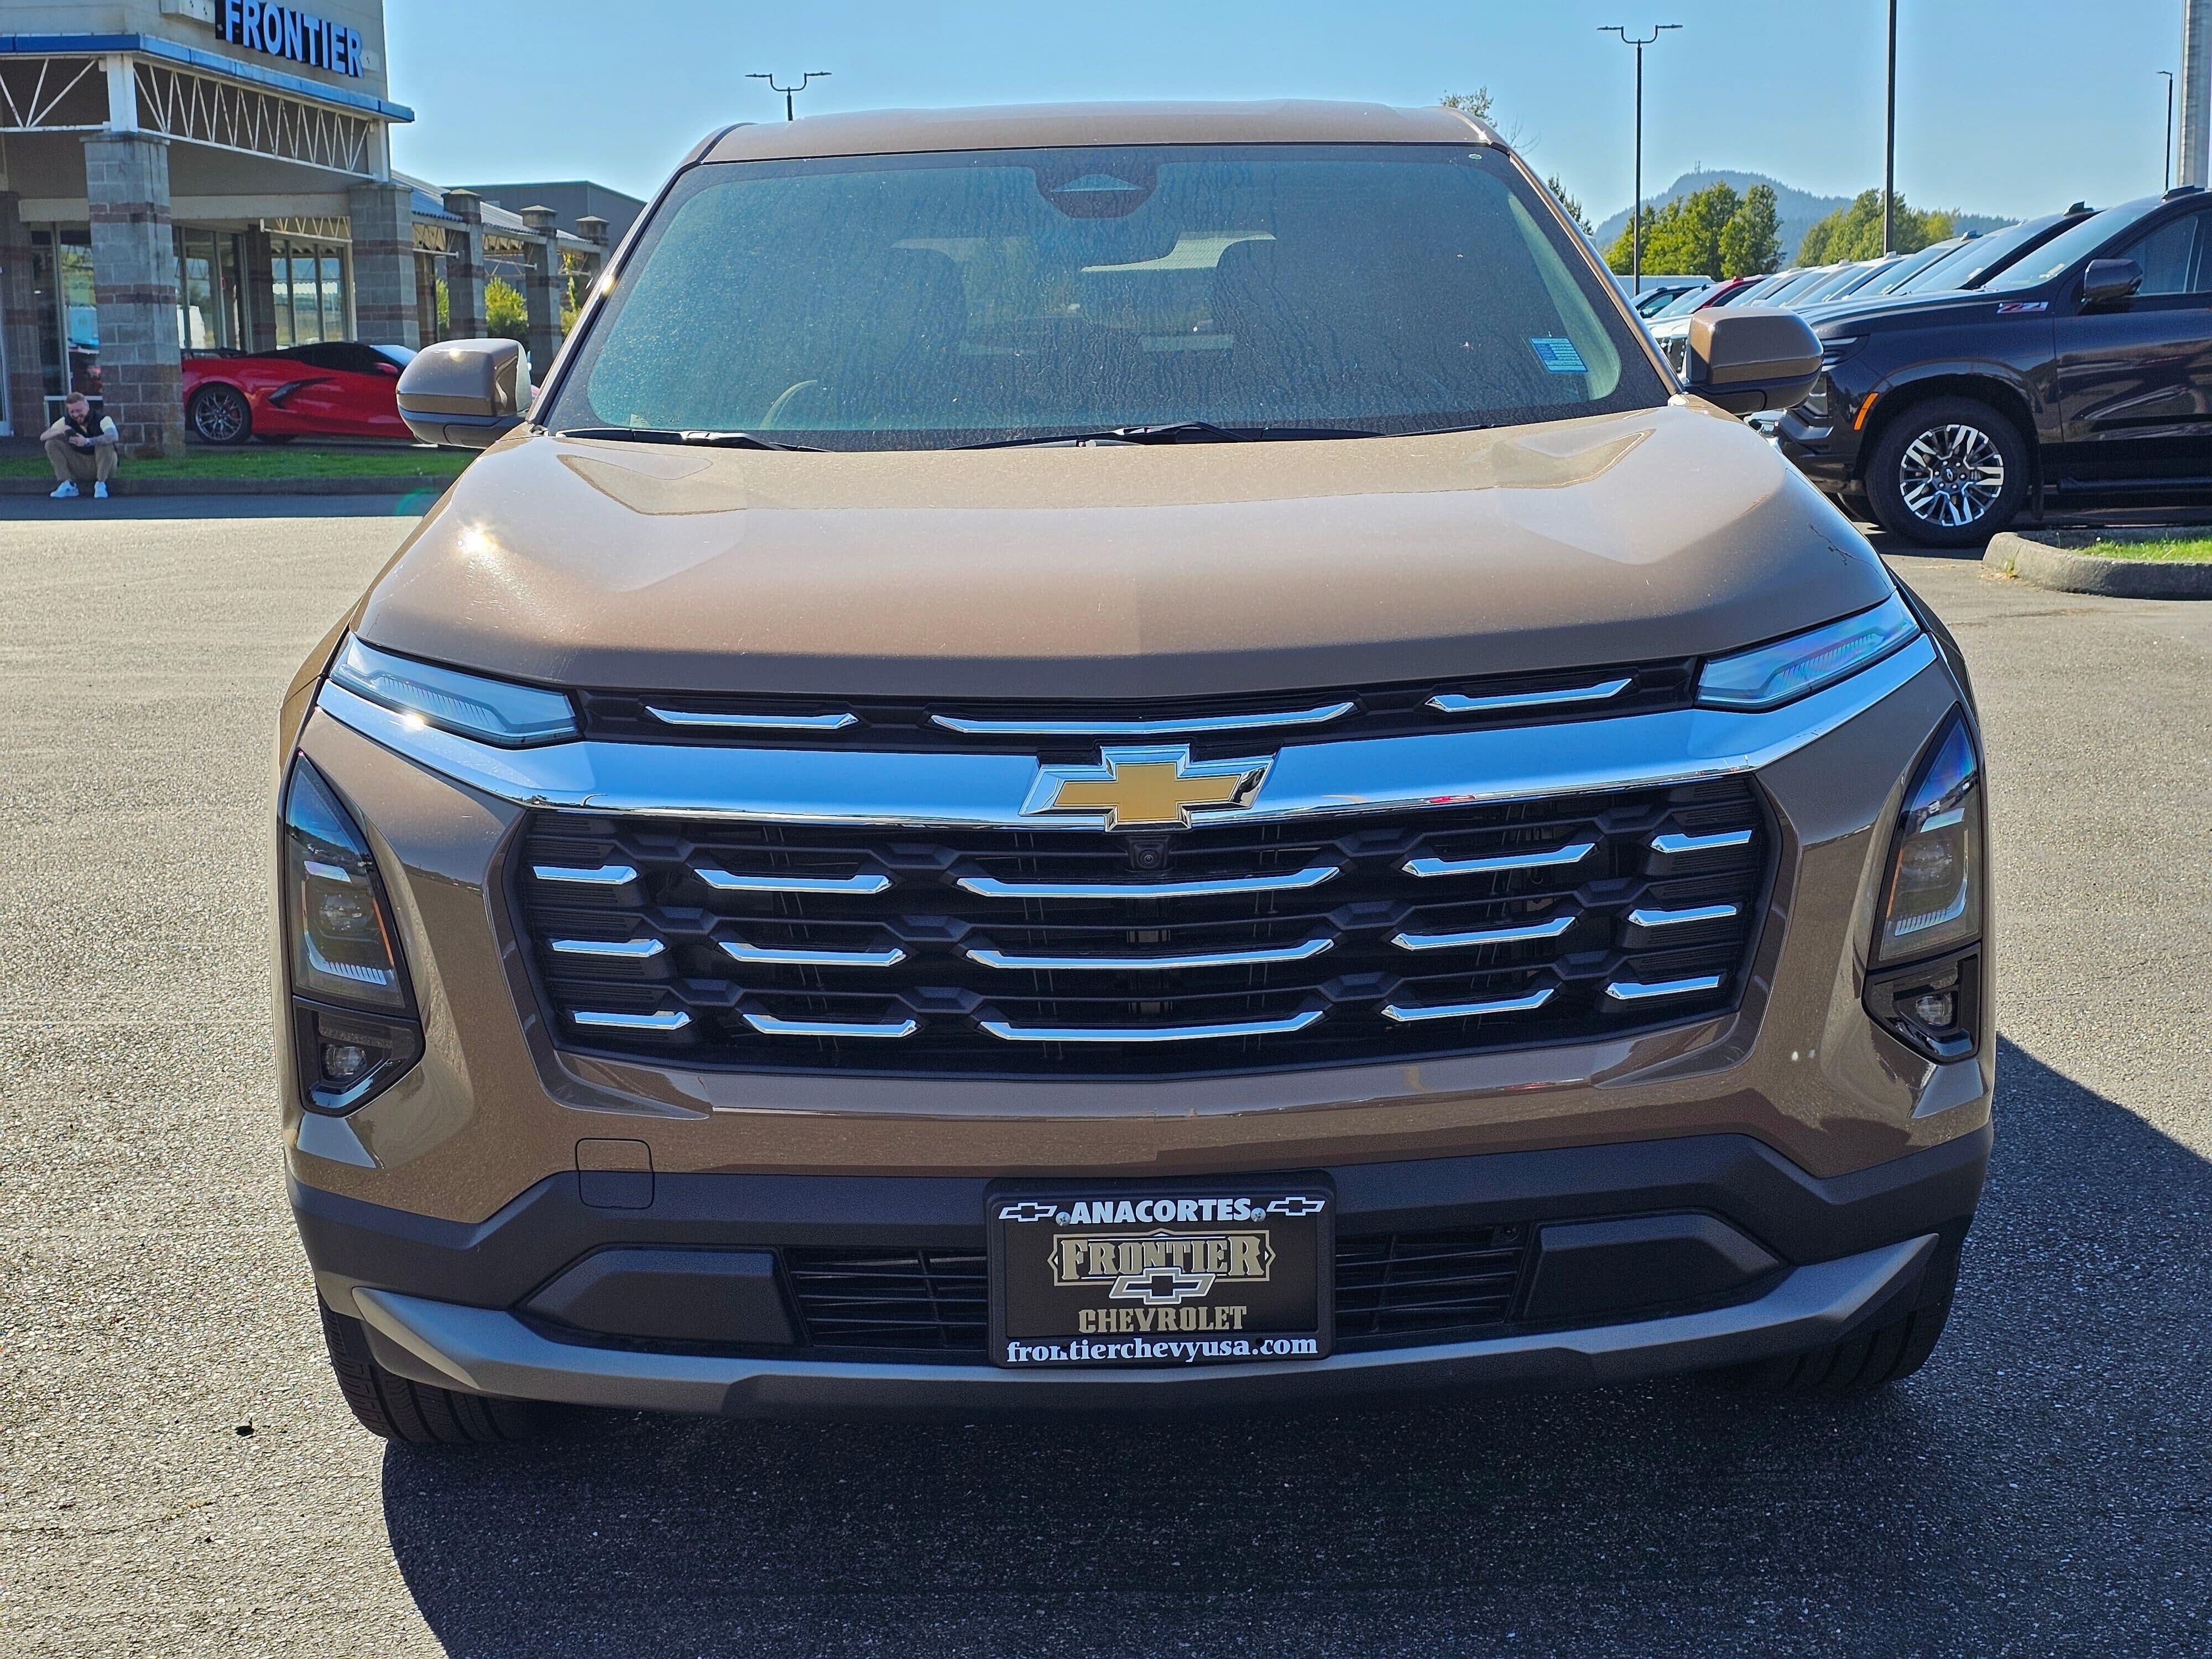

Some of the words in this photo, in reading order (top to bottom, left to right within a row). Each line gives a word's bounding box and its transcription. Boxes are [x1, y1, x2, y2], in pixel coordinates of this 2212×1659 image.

[226, 0, 363, 78] FRONTIER
[1071, 1198, 1251, 1224] ANACORTES
[1061, 1236, 1264, 1280] FRONTIER
[1078, 1306, 1247, 1333] CHEVROLET
